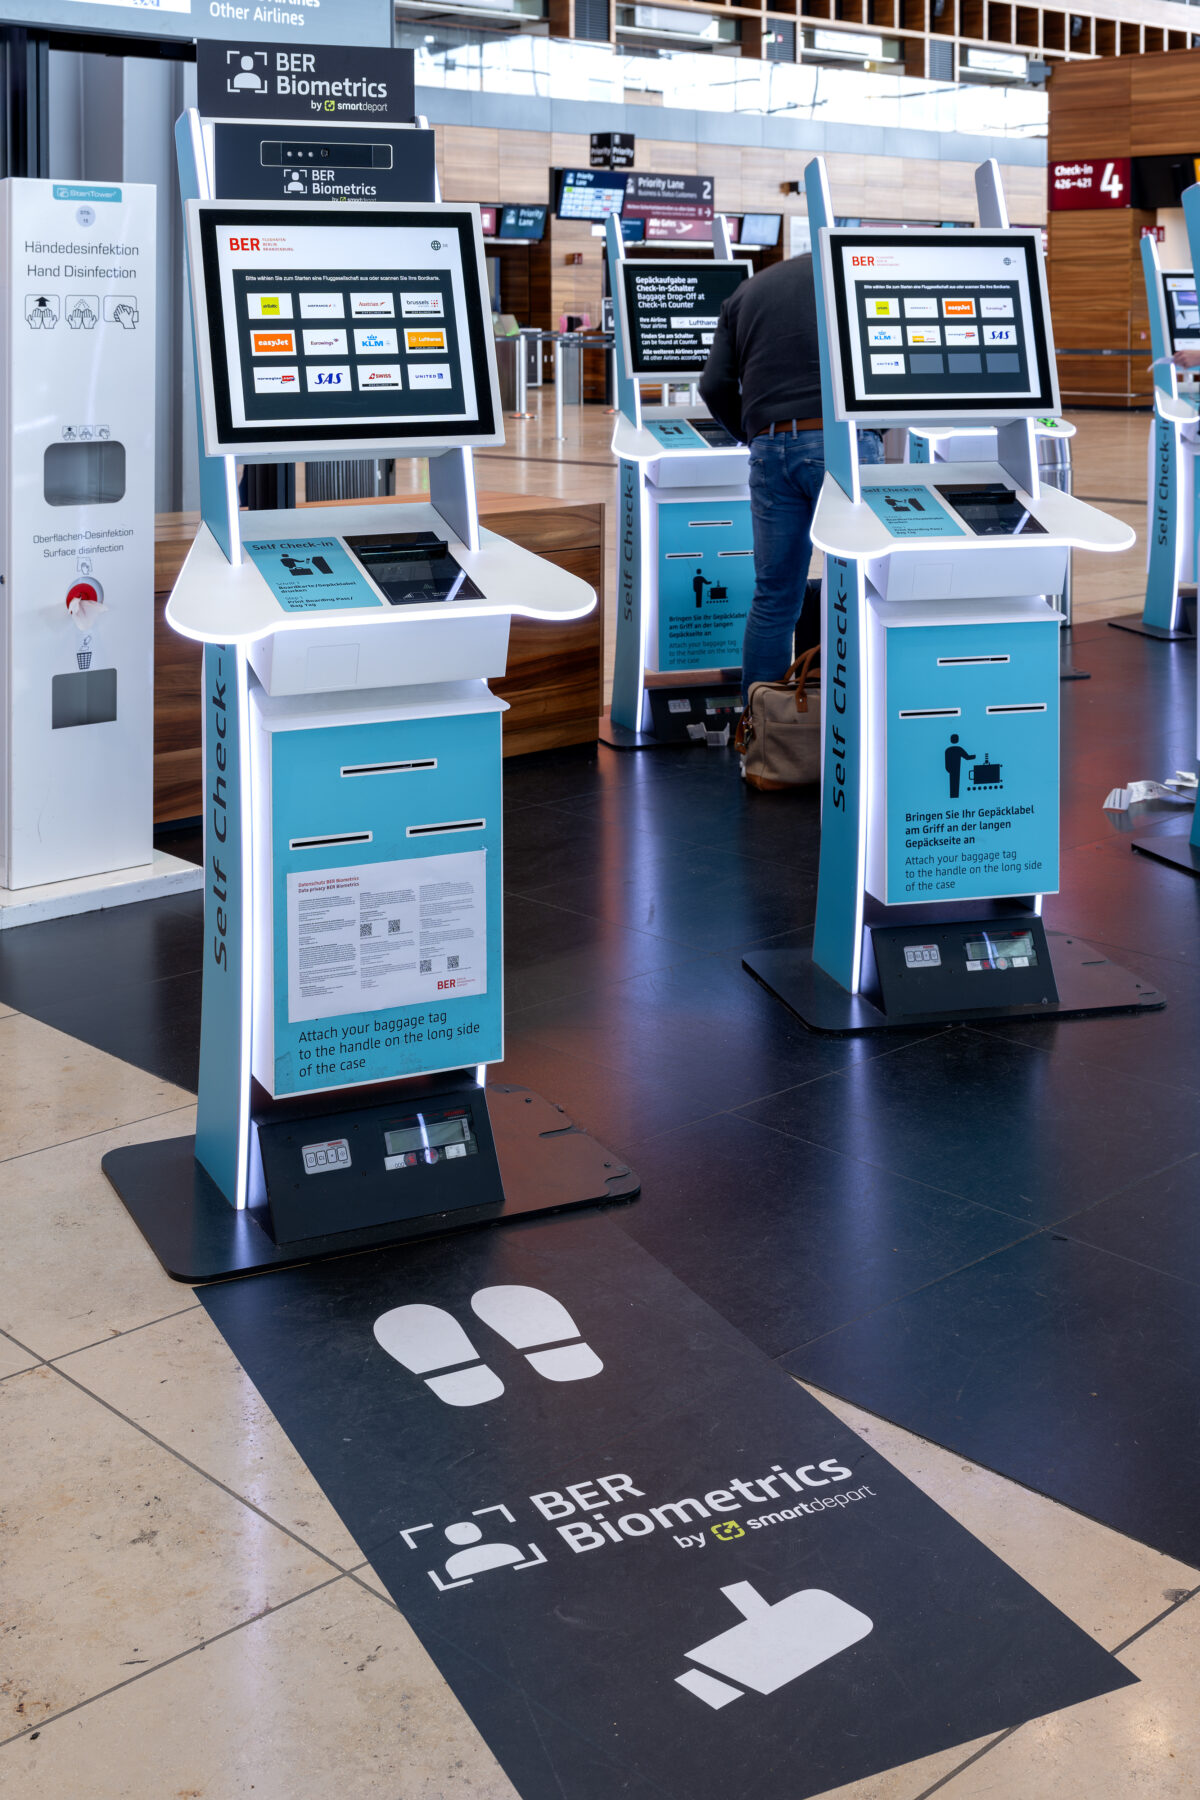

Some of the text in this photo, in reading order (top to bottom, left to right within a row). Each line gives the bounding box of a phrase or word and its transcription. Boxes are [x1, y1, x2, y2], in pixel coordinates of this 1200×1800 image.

[209, 2, 249, 20] Other
[253, 6, 305, 26] Airlines
[276, 53, 315, 72] BER
[277, 74, 387, 98] Biometrics
[311, 100, 388, 112] by smartdepart
[312, 170, 335, 181] BER
[1055, 162, 1123, 199] Check-in 4
[312, 182, 376, 195] Biometrics
[638, 178, 666, 190] Priority
[667, 179, 685, 189] Lane
[702, 181, 711, 199] 2
[520, 209, 544, 219] Priority
[25, 241, 139, 256] Händedesinfektion
[229, 237, 260, 251] BER
[852, 256, 874, 266] BER
[27, 264, 137, 279] Hand Disinfection
[635, 276, 685, 285] Gepäckaufgabe
[636, 284, 695, 292] Check-in-Schalter
[637, 293, 666, 301] Baggage
[667, 293, 696, 301] Drop-Off
[989, 331, 1010, 339] SAS
[314, 373, 343, 384] SAS
[1157, 504, 1168, 546] Self
[33, 528, 133, 544] Oberflächen-Desinfektion
[624, 464, 634, 622] Self Check-i
[44, 544, 124, 558] Surface disinfection
[252, 541, 334, 551] Self Check-in
[832, 557, 848, 813] Self Check-i
[905, 805, 1035, 823] Bringen Sie Ihr Gepäcklabel
[905, 827, 920, 835] am
[922, 824, 945, 834] Griff
[961, 822, 977, 831] der
[979, 820, 1011, 831] langen
[905, 836, 975, 850] Gepäckseite an
[905, 850, 1017, 865] Attach your baggage tag
[905, 861, 1042, 879] to the handle on the long side
[905, 880, 956, 892] of the case
[214, 855, 227, 972] Self
[437, 979, 456, 990] BER
[299, 1011, 447, 1044] Attach your baggage tag
[299, 1022, 480, 1060] to the handle on the long side
[299, 1058, 366, 1078] of the case
[529, 1472, 646, 1522] BER
[555, 1457, 854, 1554] Biometrics
[672, 1484, 877, 1550] by smartdepart
